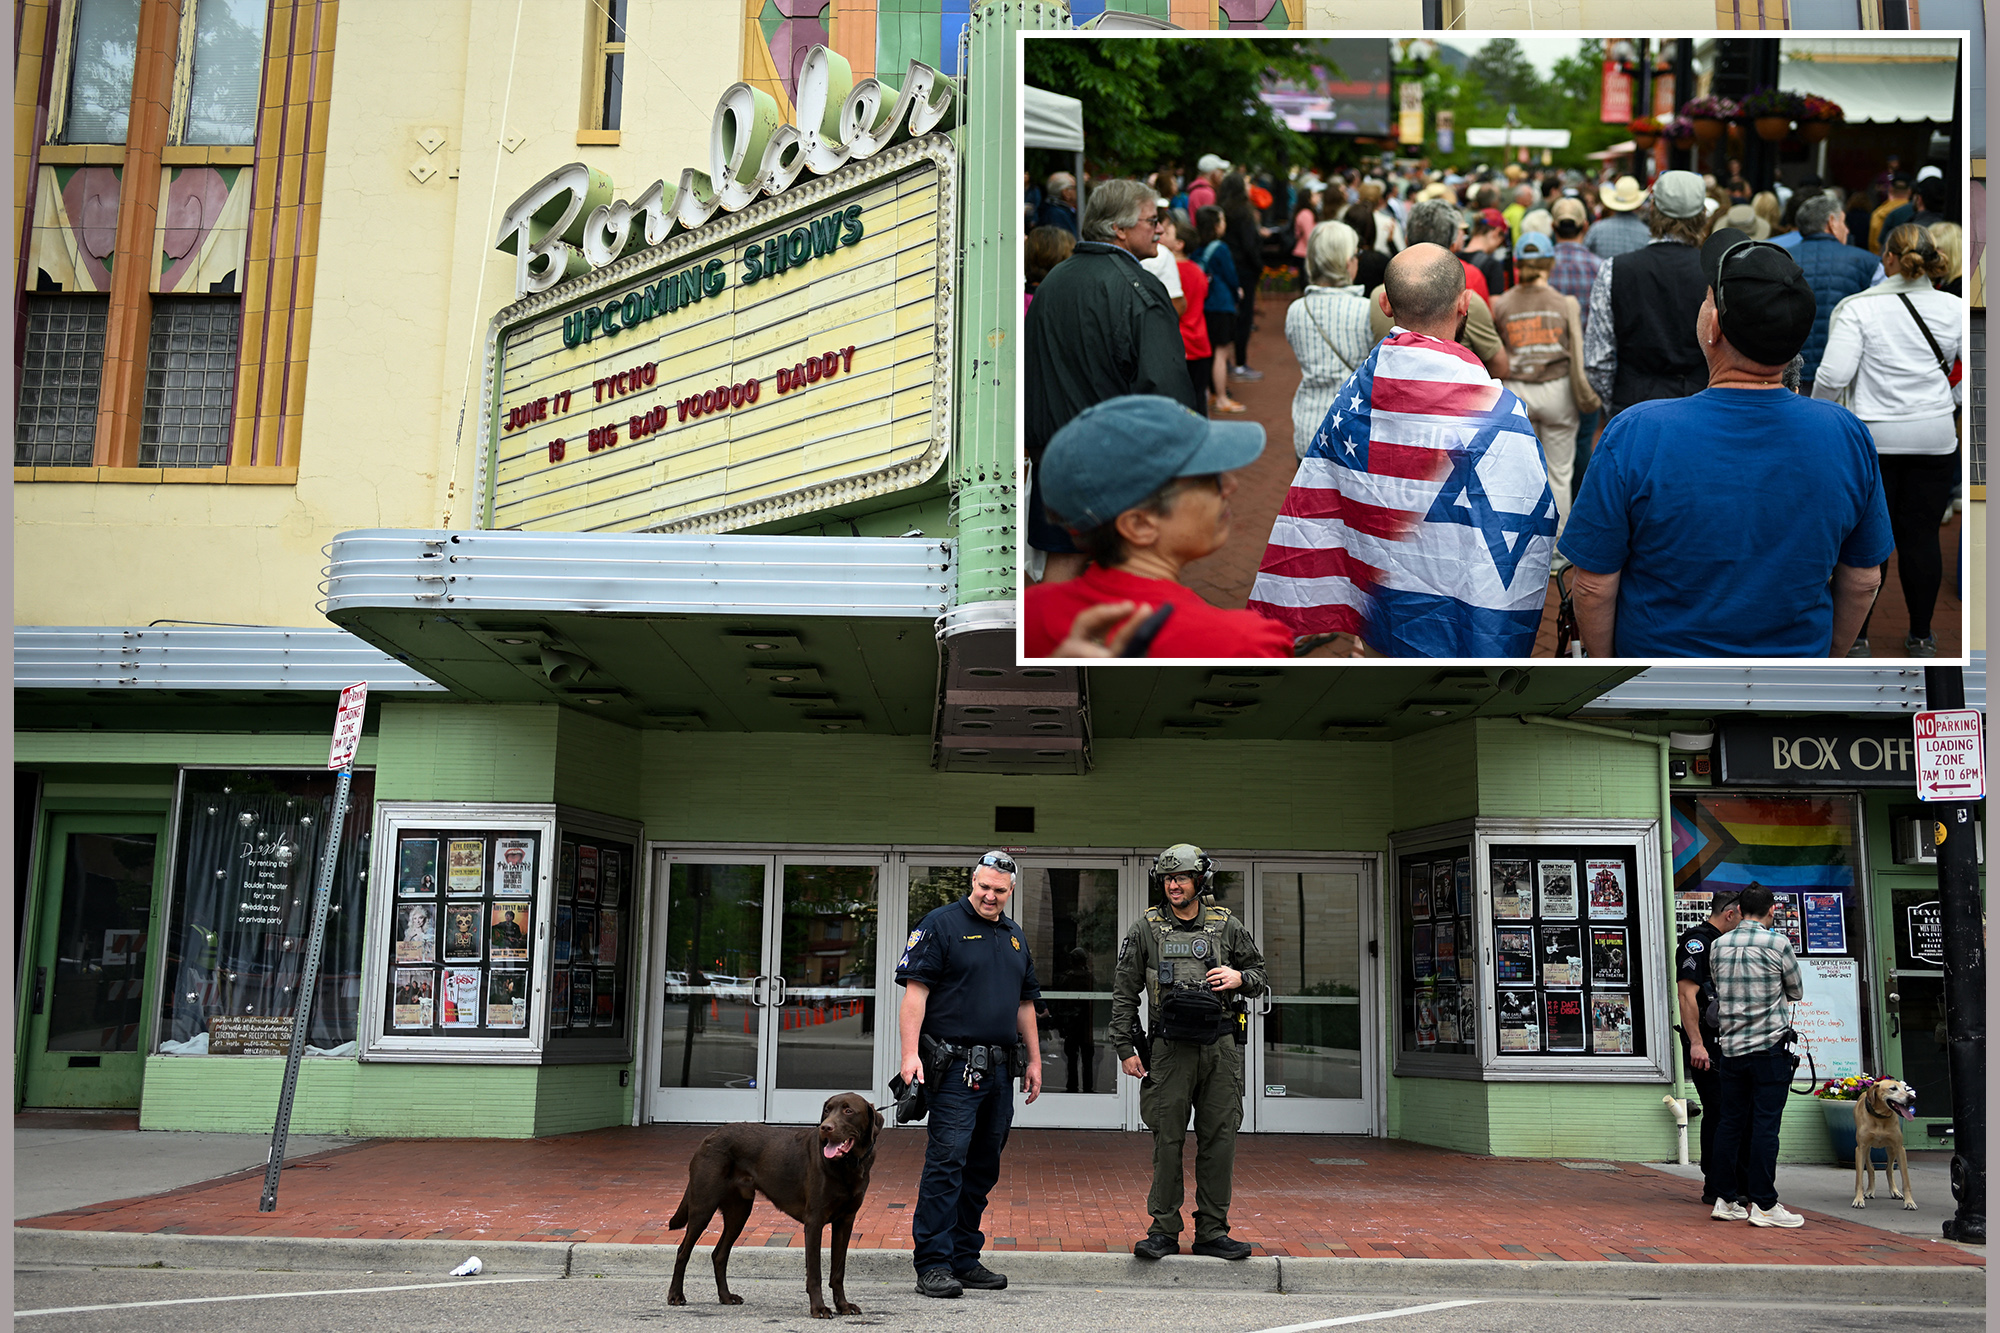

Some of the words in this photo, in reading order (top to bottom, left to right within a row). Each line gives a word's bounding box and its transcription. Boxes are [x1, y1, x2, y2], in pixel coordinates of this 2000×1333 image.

[496, 43, 965, 300] Boulder
[563, 257, 726, 349] UPCOMING
[741, 204, 865, 285] SHOWS
[503, 397, 548, 431] JUNE
[552, 389, 572, 414] 17
[592, 361, 657, 403] TYCHO
[588, 423, 618, 452] BIG
[629, 405, 667, 440] BAD
[676, 378, 760, 422] VOODOO
[776, 345, 856, 394] DADDY
[340, 707, 361, 723] LOADING
[341, 722, 355, 736] ZONE
[1916, 718, 1935, 736] NO
[1935, 719, 1977, 733] PARKING
[1926, 739, 1974, 752] LOADING
[1772, 736, 1841, 771] BOX
[1935, 754, 1966, 766] ZONE
[1922, 769, 1940, 781] 7AM
[1944, 769, 1956, 781] TO
[1959, 768, 1979, 780] 6PM
[248, 859, 256, 867] by
[257, 860, 277, 868] renting
[278, 860, 288, 868] the
[243, 881, 265, 889] Boulder
[266, 882, 288, 890] Theater
[262, 893, 276, 901] your
[245, 904, 268, 912] wedding
[269, 905, 280, 913] day
[245, 916, 266, 924] private
[266, 917, 283, 925] party
[1165, 943, 1190, 954] EOD
[1560, 1007, 1580, 1015] DISKO
[249, 1032, 277, 1040] RECEPTION
